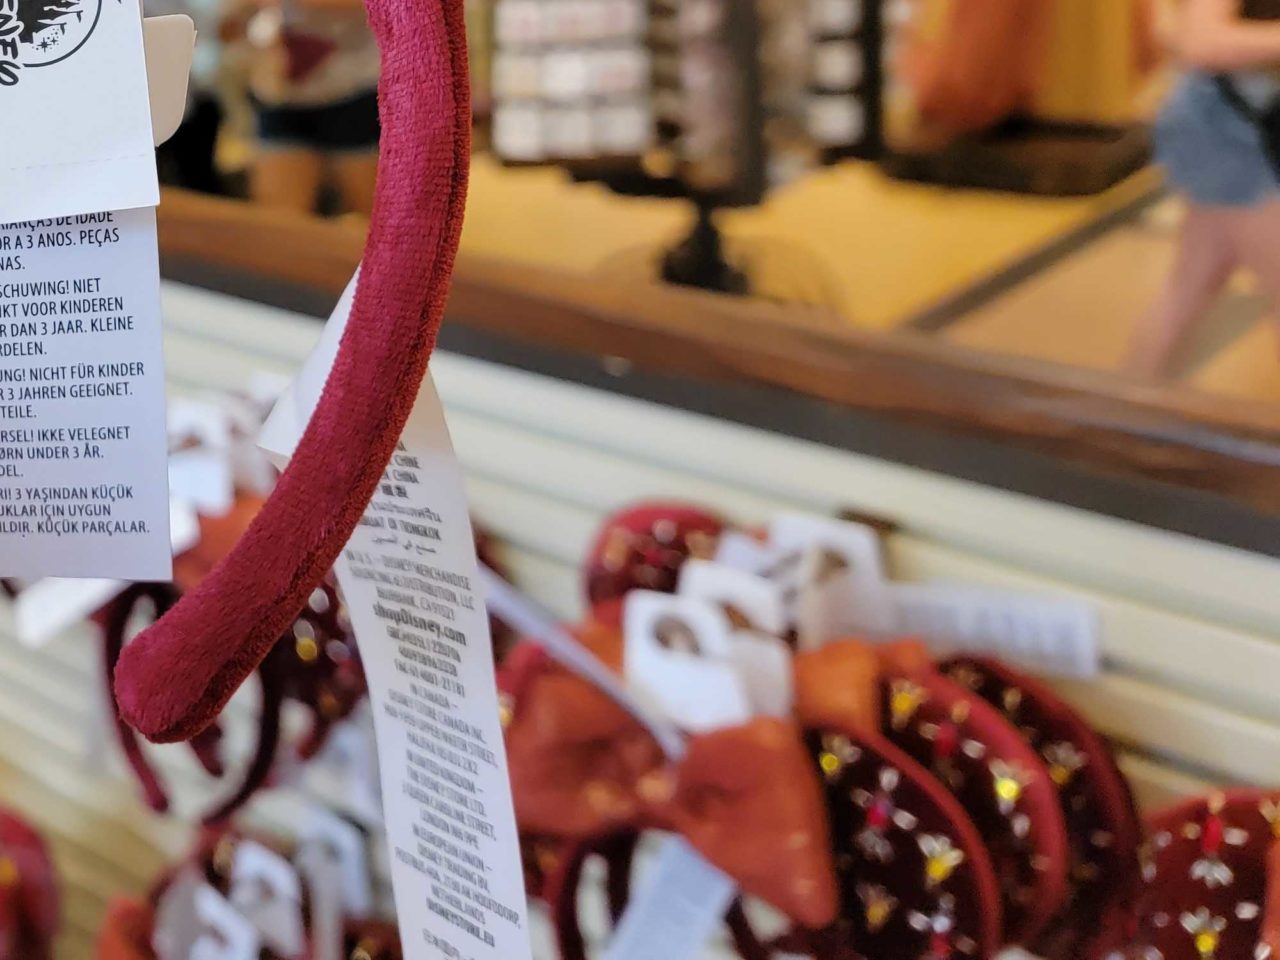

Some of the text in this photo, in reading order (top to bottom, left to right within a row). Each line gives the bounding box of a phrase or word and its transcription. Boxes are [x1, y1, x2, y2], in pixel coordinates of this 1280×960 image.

[56, 215, 72, 226] DE
[76, 211, 114, 225] IDADE
[15, 236, 23, 250] A
[26, 235, 34, 249] 3
[37, 231, 76, 248] ANOS.
[79, 227, 120, 247] PEÇAS
[73, 278, 101, 294] NIET
[22, 301, 57, 317] VOOR
[60, 296, 123, 315] KINDEREN
[11, 322, 37, 338] DAN
[41, 322, 48, 335] 3
[51, 319, 87, 335] JAAR.
[91, 316, 134, 332] KLEINE
[30, 366, 67, 382] NICHT
[70, 362, 95, 380] FÜR
[98, 361, 145, 378] KINDER
[8, 388, 15, 401] 3
[18, 385, 67, 400] JAHREN
[70, 382, 133, 398] GEEIGNET.
[37, 428, 65, 441] IKKE
[67, 426, 131, 440] VELEGNET
[27, 446, 70, 460] UNDER
[73, 446, 80, 459] 3
[83, 442, 104, 458] ÅR.
[16, 488, 22, 500] 3
[25, 486, 88, 503] YAŞINDAN
[91, 484, 134, 502] KÜÇÜK
[68, 503, 111, 517] UYGUN
[37, 519, 79, 536] KÜÇÜK
[82, 520, 150, 536] PARÇALAR.
